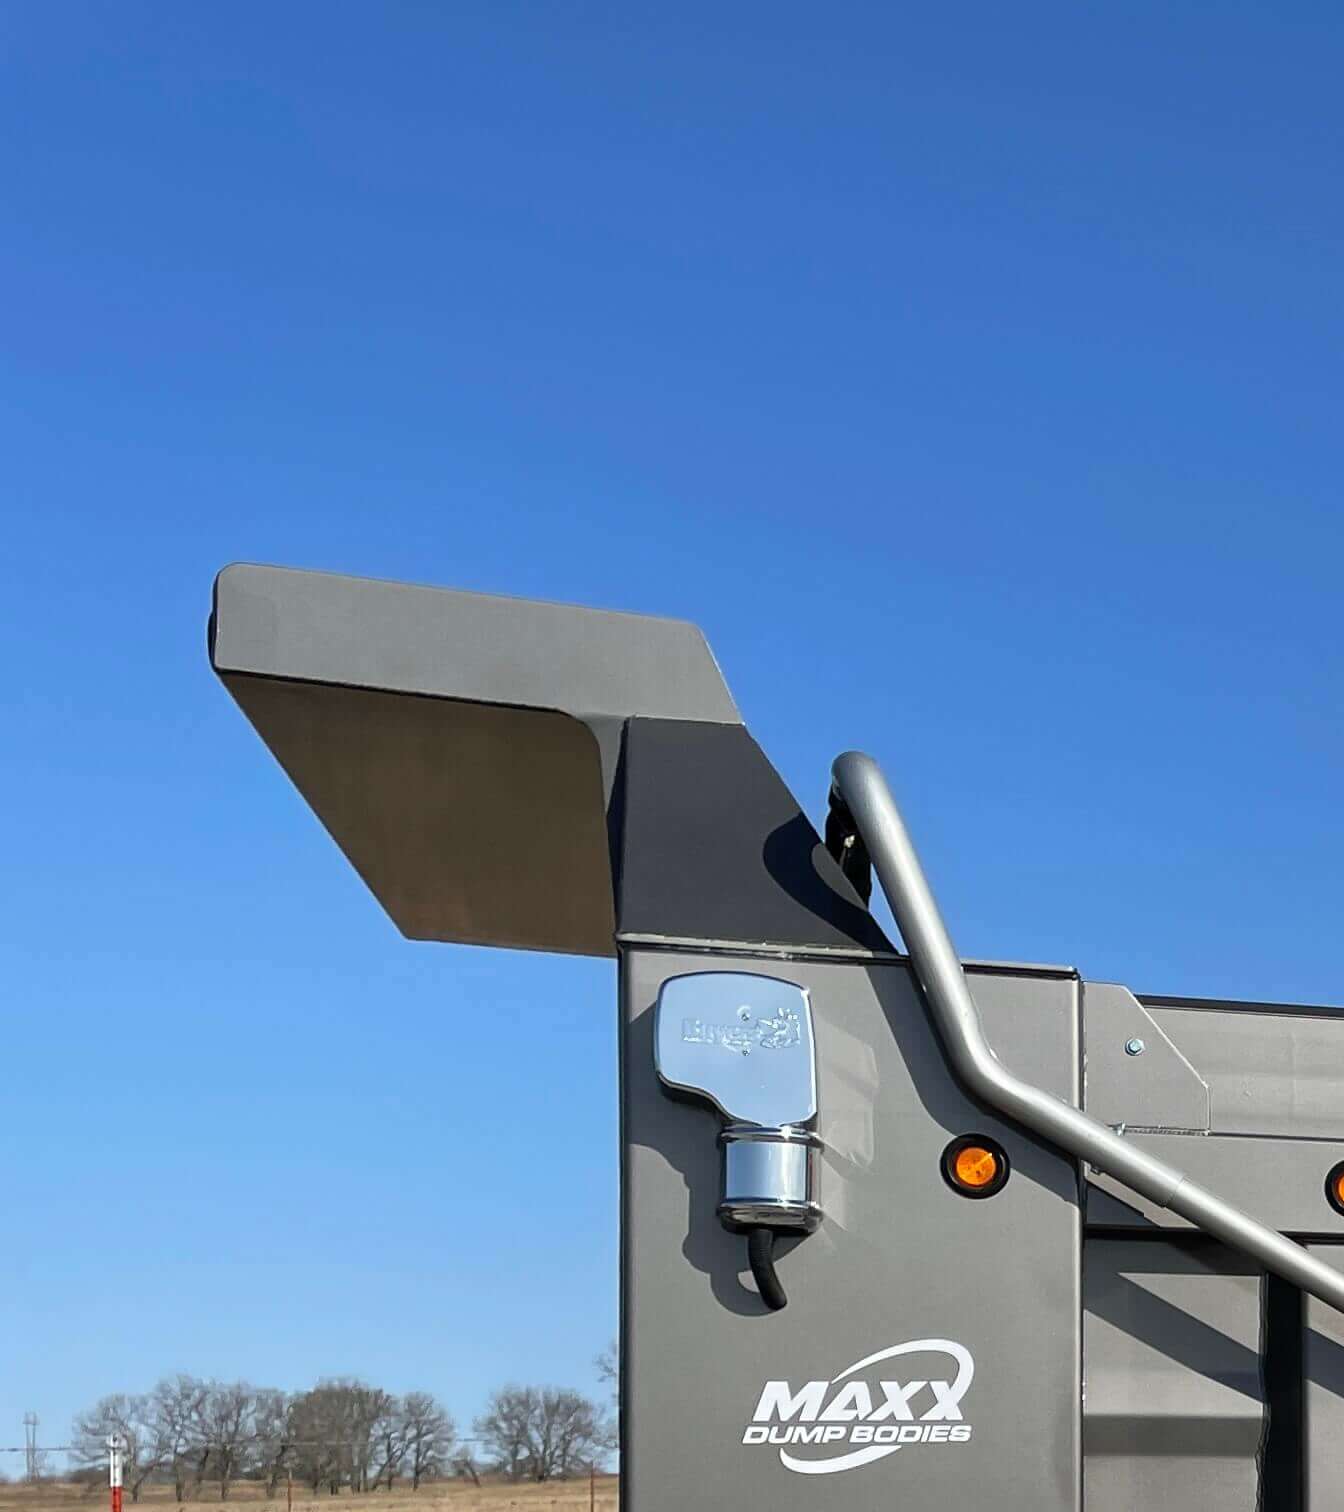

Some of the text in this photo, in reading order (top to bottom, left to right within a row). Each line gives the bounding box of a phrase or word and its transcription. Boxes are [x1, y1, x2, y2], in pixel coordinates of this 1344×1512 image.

[752, 1381, 973, 1421] MAXX
[742, 1425, 972, 1444] DUMP BODIES
